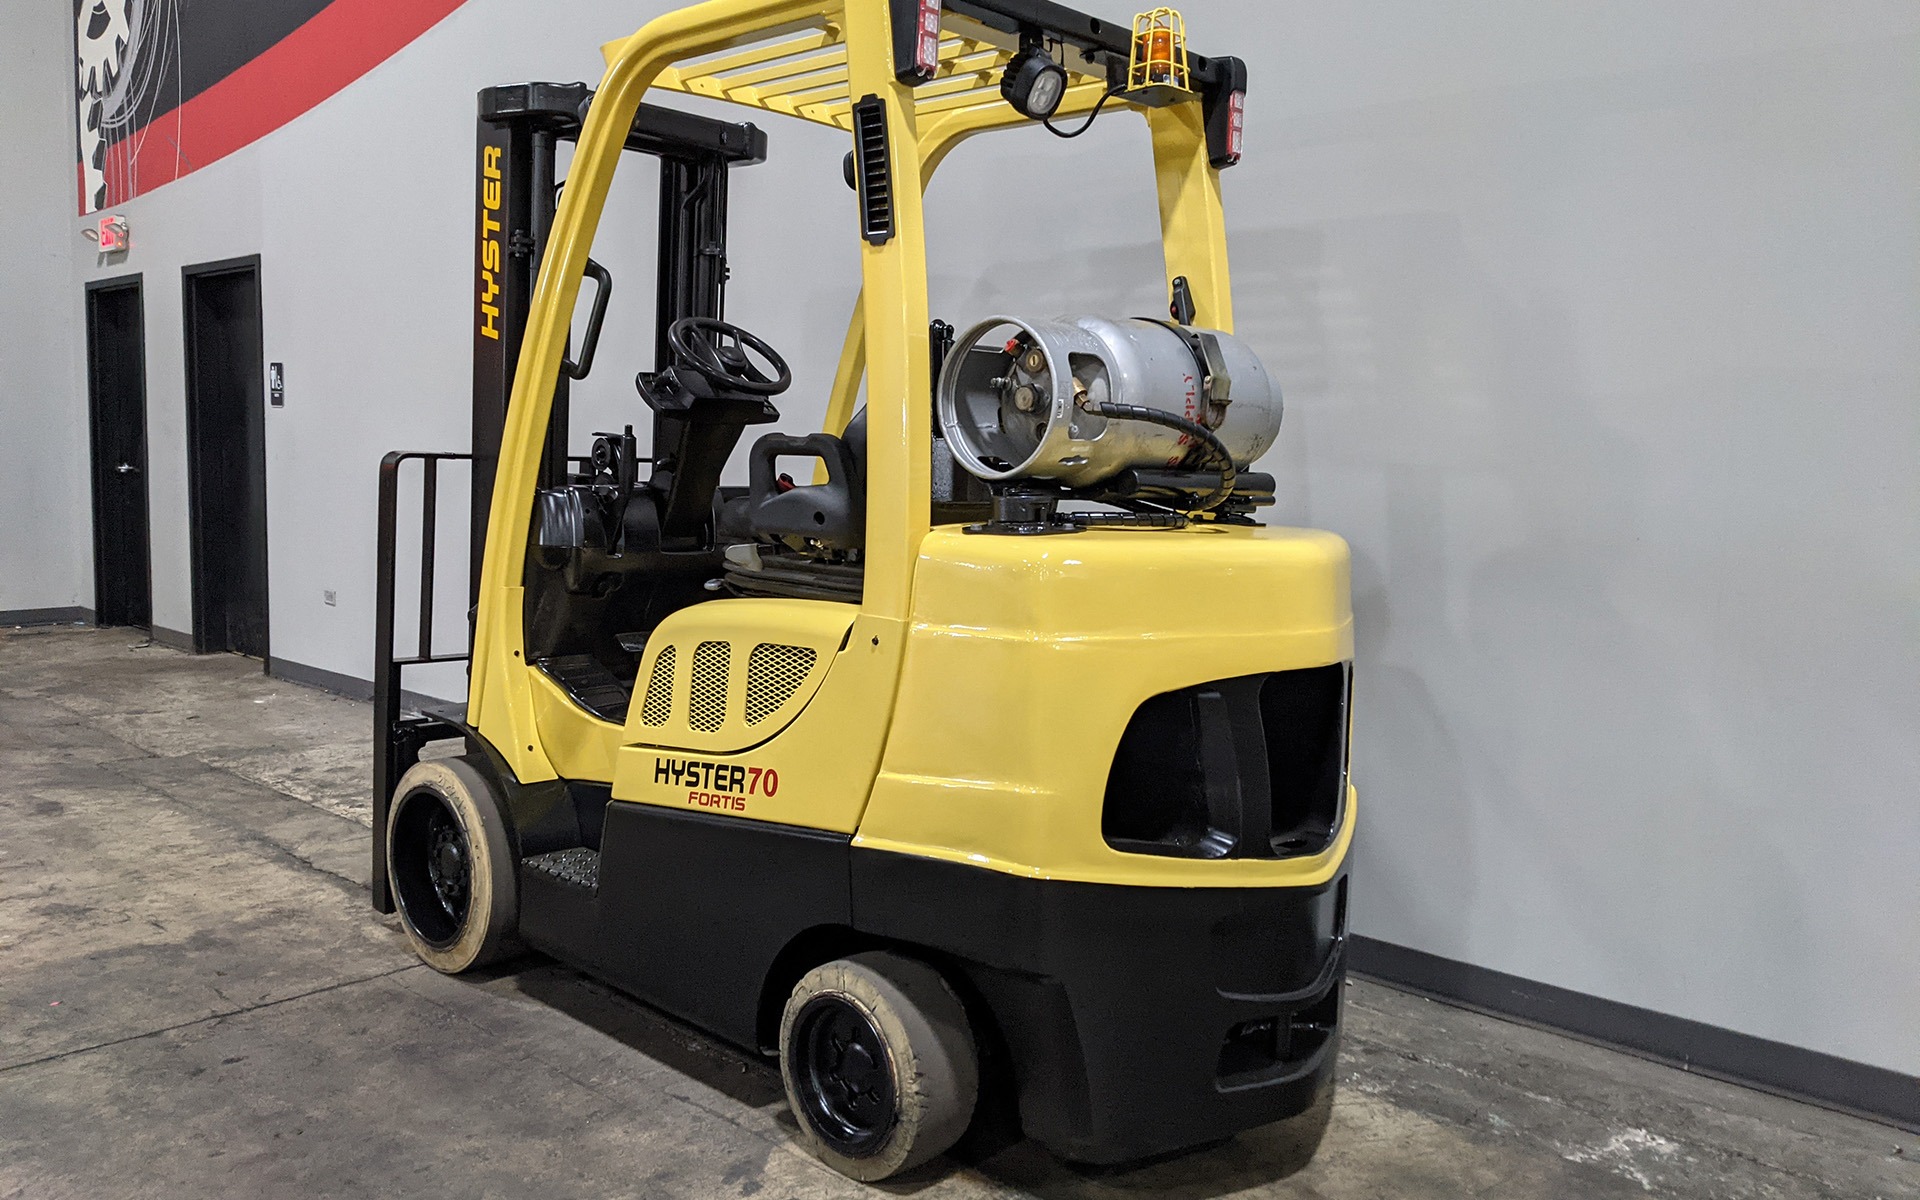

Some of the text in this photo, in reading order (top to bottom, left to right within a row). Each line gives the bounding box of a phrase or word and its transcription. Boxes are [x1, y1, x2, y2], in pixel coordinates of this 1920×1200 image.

[481, 145, 501, 340] HYSTER
[1177, 373, 1196, 446] SPPLY
[654, 758, 778, 797] HYSTER 70
[688, 791, 746, 811] FORTIS
